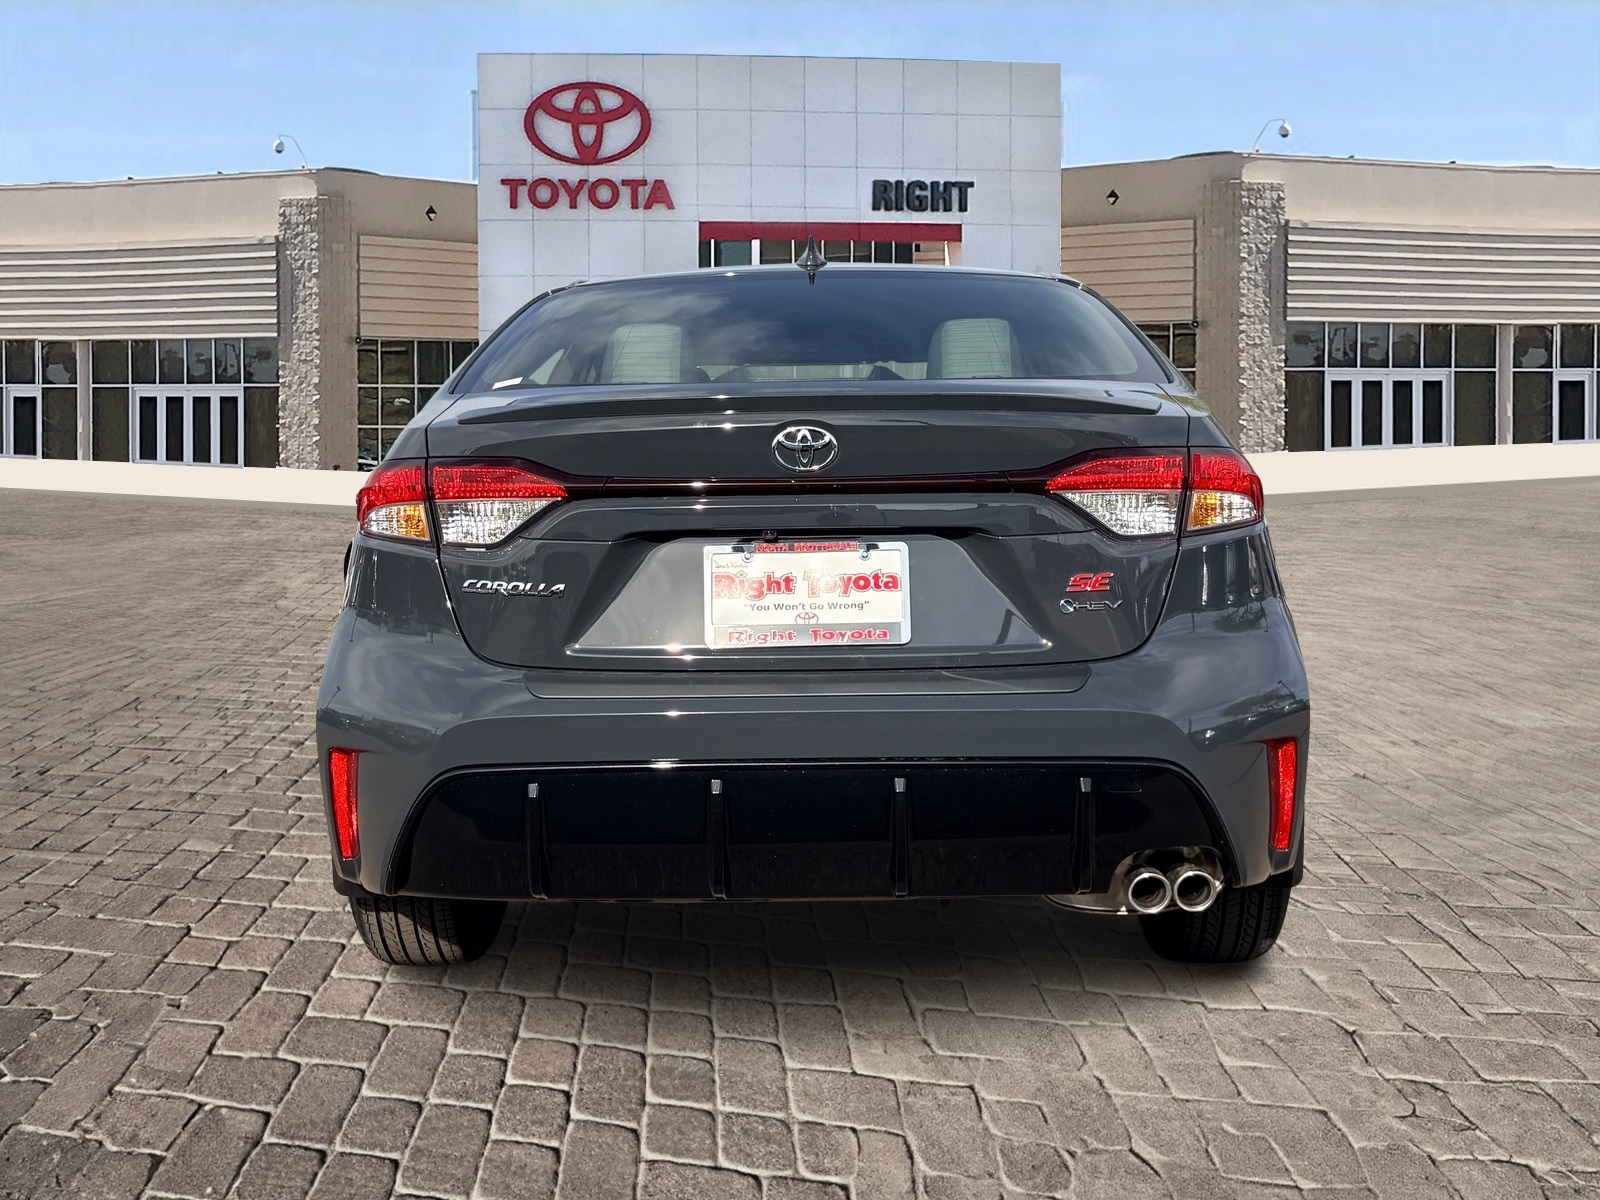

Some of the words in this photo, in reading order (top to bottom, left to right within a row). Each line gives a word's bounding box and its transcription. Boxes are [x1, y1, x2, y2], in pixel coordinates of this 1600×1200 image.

[500, 177, 676, 210] TOYOTA
[872, 179, 975, 212] RIGHT
[462, 579, 566, 598] COROLLA
[712, 570, 798, 600] Right
[803, 568, 902, 598] Toyota
[1066, 572, 1114, 592] SE
[774, 602, 806, 611] Won't
[809, 602, 824, 610] Go
[727, 629, 797, 645] Right
[809, 628, 890, 644] Toyota
